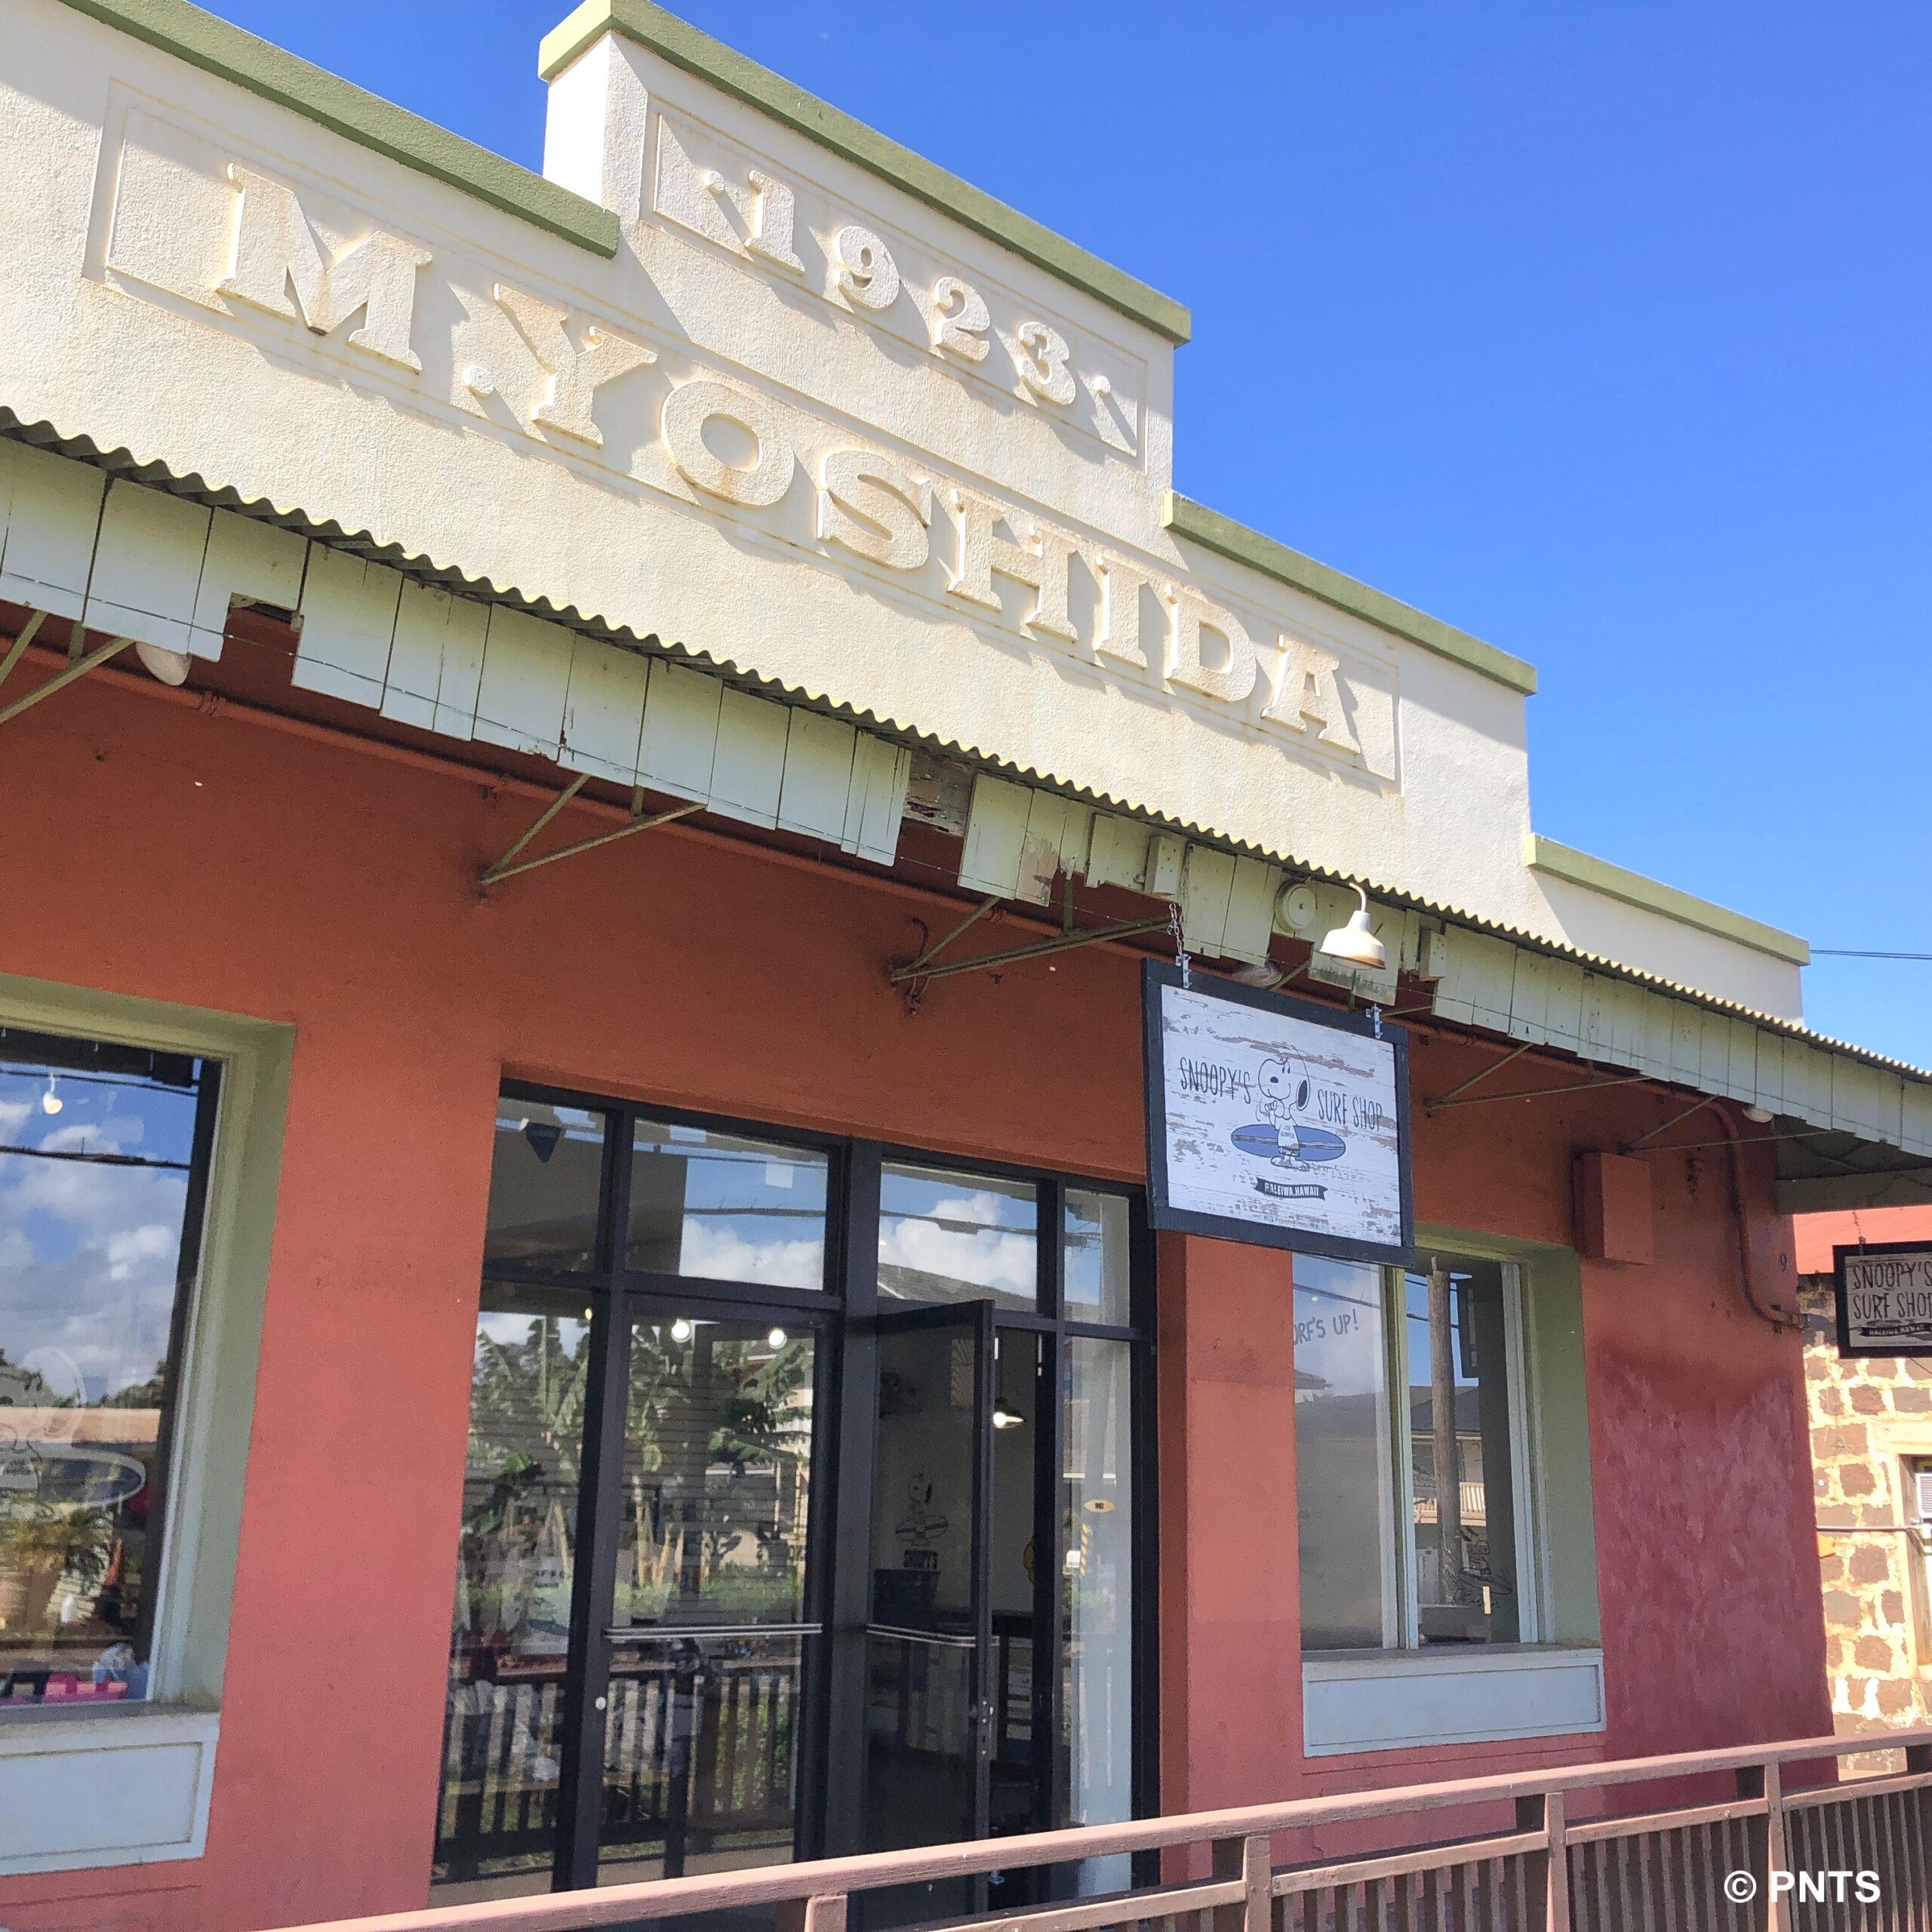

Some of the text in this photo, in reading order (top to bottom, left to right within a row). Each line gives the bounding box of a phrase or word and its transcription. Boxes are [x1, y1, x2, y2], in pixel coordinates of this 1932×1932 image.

[745, 169, 1076, 405] 1923
[1180, 1057, 1251, 1105] SNOOPY'S
[1317, 1088, 1383, 1132] SURF SHOP
[1853, 1261, 1932, 1290] SNOOPY'S
[1332, 1308, 1358, 1335] UP!
[1853, 1292, 1890, 1319] SURF
